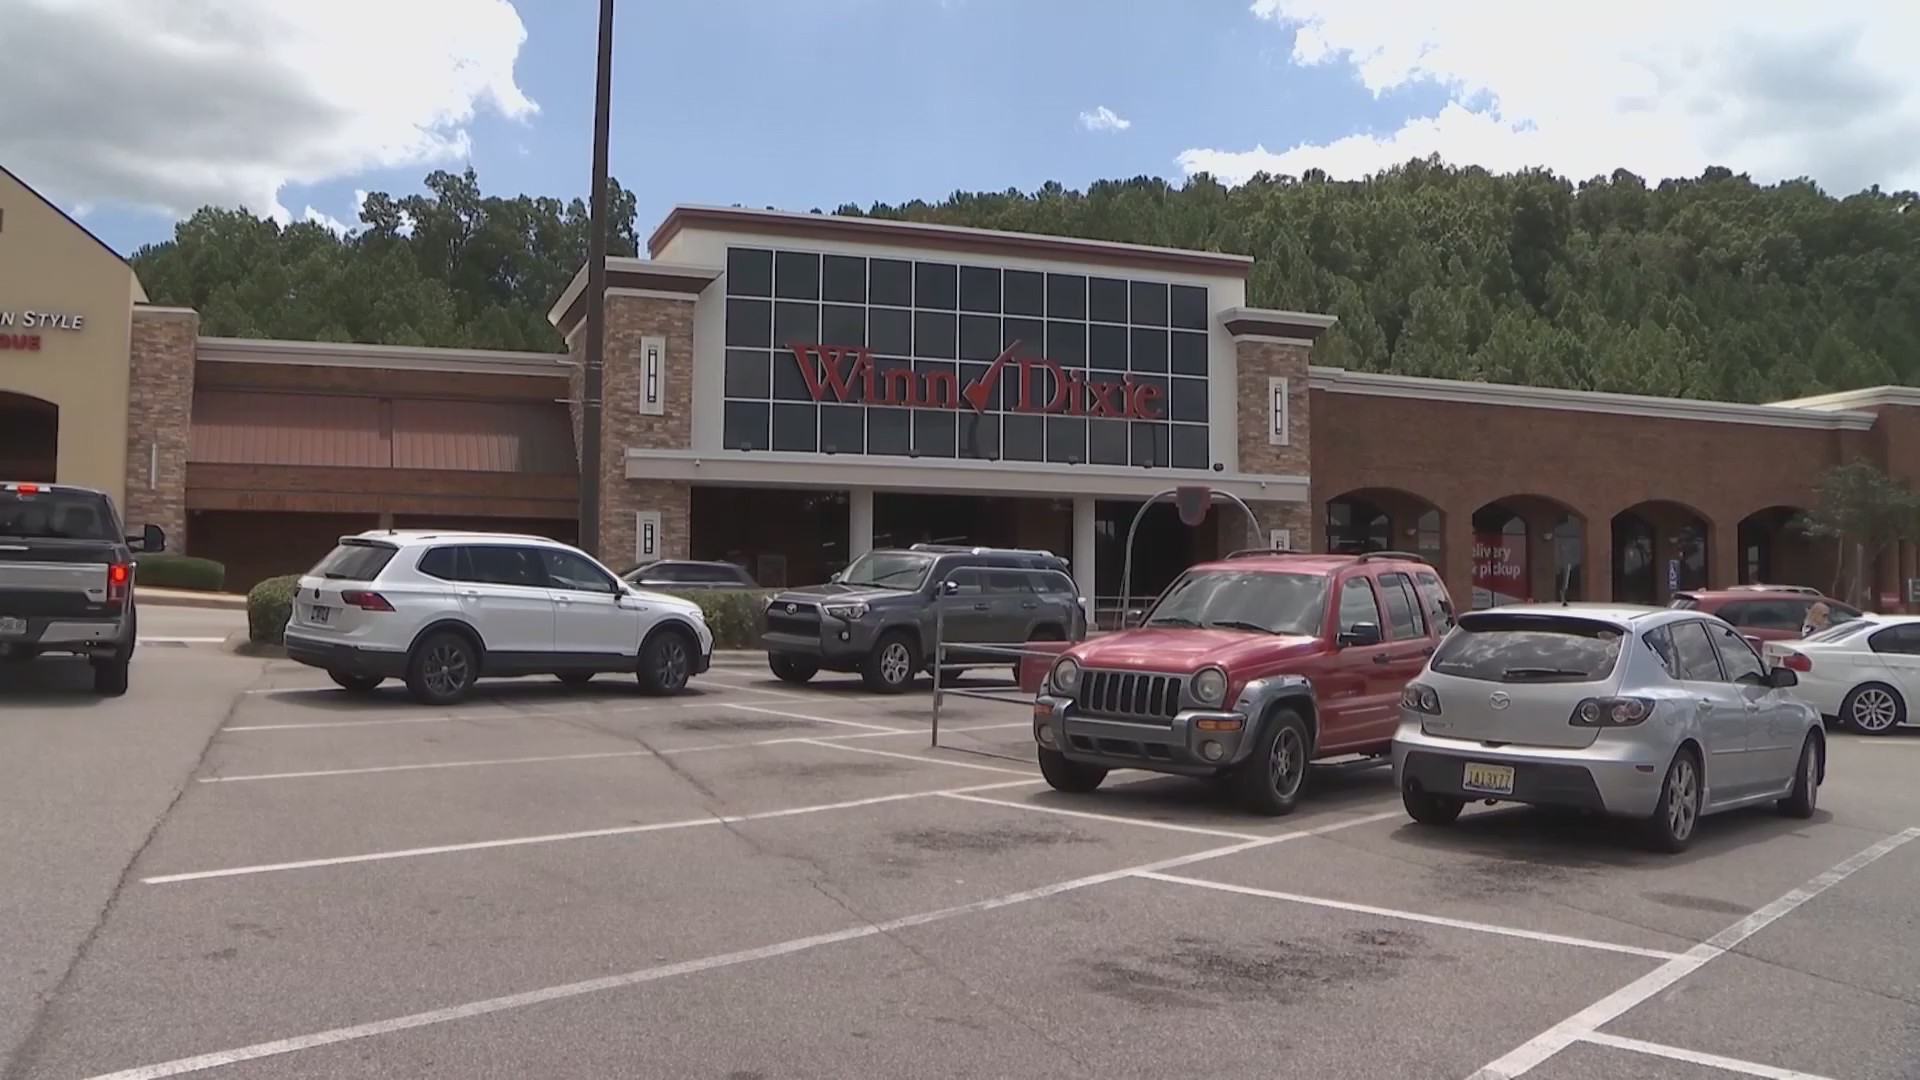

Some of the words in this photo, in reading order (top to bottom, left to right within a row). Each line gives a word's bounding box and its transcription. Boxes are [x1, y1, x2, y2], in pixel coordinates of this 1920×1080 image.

[22, 310, 84, 330] STYLE
[784, 342, 960, 408] Winn
[1010, 356, 1164, 419] Dixie
[1480, 561, 1521, 579] pickup
